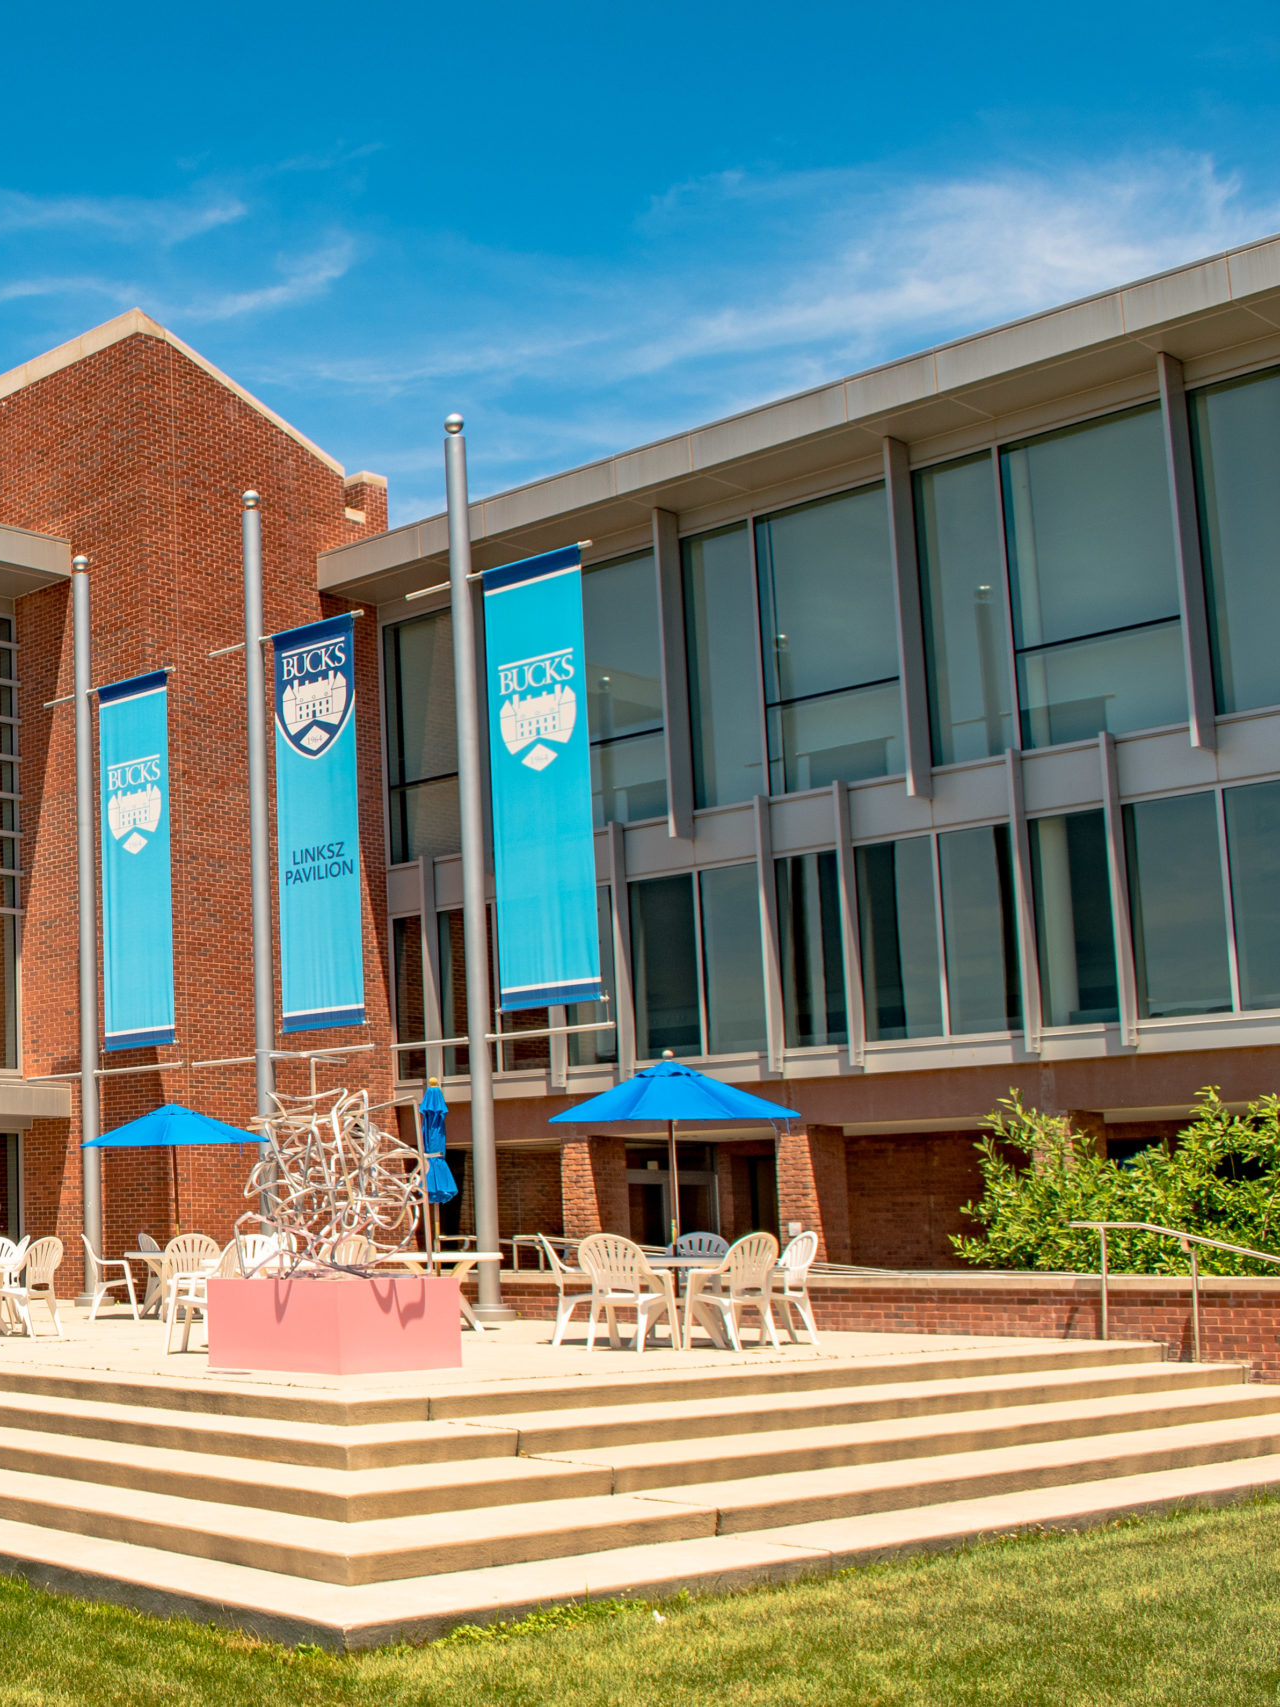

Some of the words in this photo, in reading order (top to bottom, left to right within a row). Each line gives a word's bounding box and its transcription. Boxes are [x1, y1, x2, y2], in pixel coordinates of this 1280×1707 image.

[281, 643, 346, 681] BUCKS
[499, 654, 575, 696] BUCKS
[108, 759, 161, 791] BUCKS
[292, 841, 345, 866] LINKSZ
[285, 859, 354, 887] PAVILION
